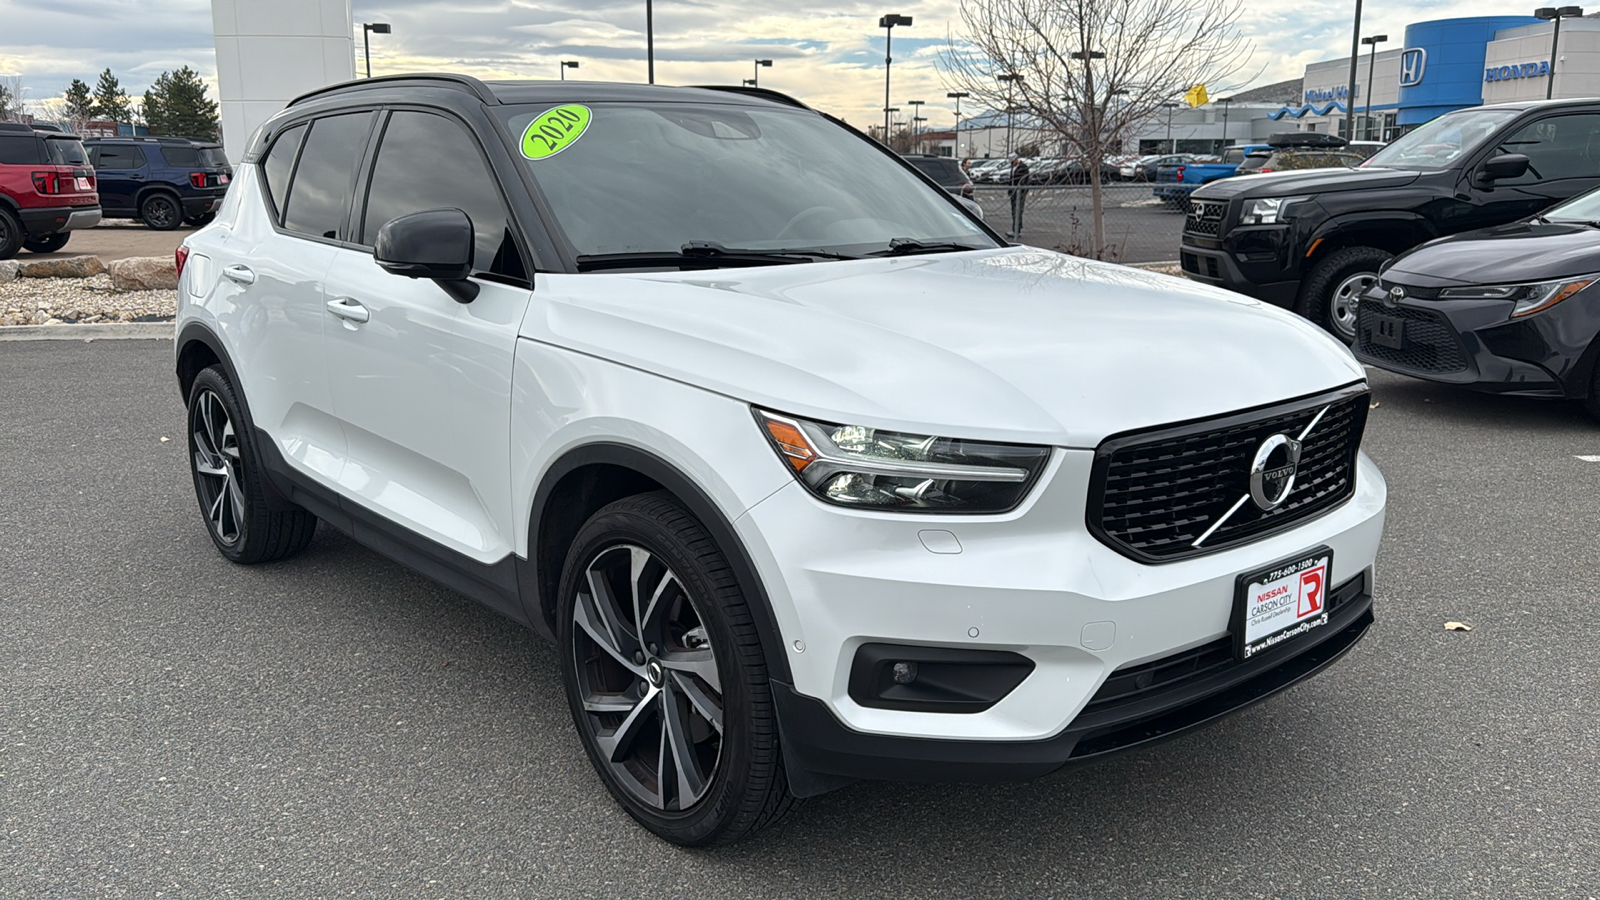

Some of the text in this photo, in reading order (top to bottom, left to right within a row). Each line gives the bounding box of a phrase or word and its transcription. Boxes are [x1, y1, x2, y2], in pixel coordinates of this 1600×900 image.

[1484, 61, 1550, 82] HONDA
[1304, 87, 1335, 103] Michael
[531, 109, 580, 151] 2020
[1264, 466, 1295, 481] VOLVO
[1269, 559, 1313, 581] 775-600-1500
[1257, 585, 1288, 603] NISSAN
[1251, 593, 1293, 617] CARSON CITY
[1251, 618, 1321, 653] www.NissanCarsonCity.com
